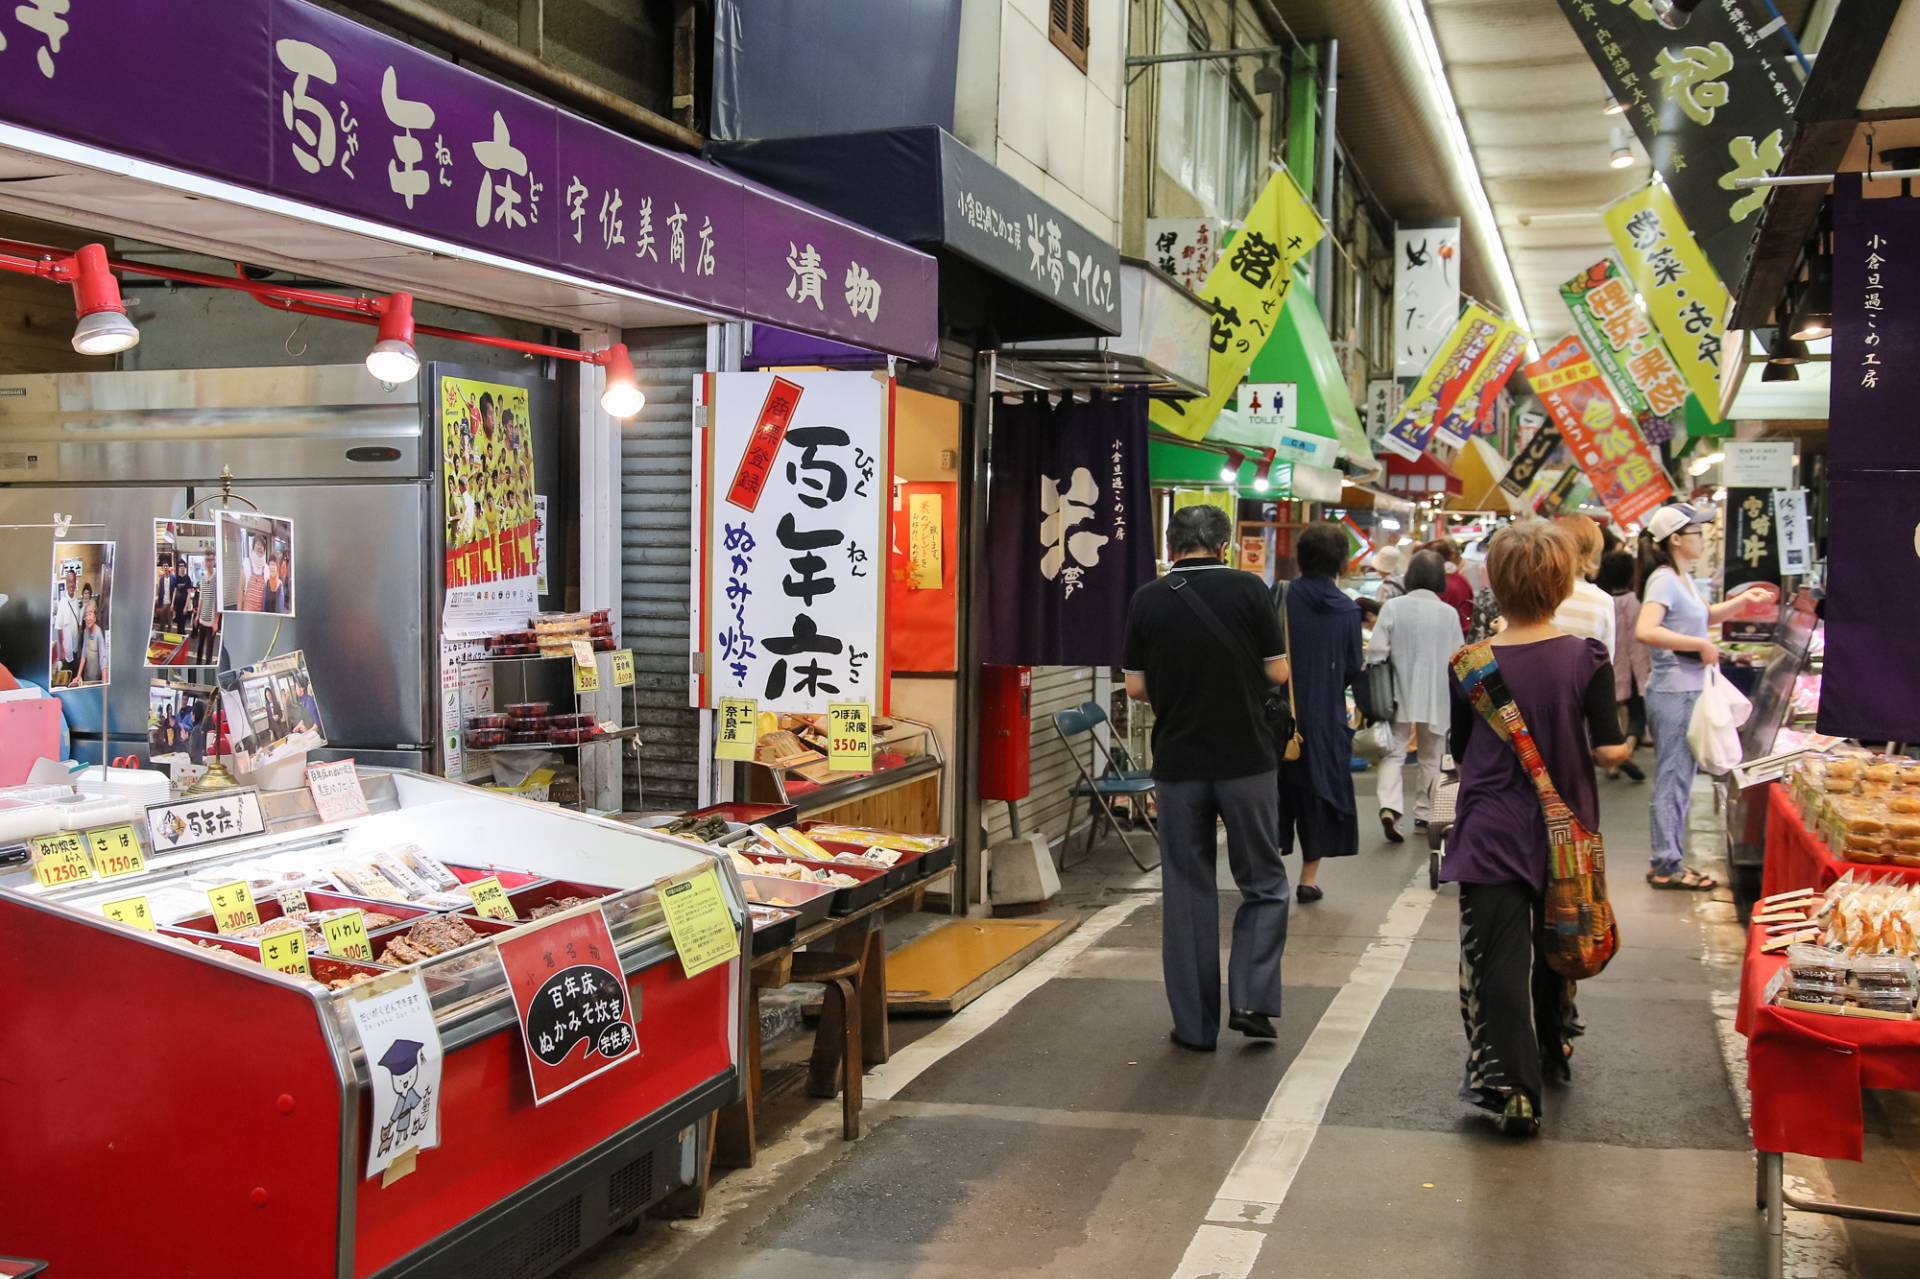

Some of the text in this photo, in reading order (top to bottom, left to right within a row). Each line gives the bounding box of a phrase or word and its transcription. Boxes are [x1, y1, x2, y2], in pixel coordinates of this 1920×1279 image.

[435, 135, 452, 187] ねん
[529, 172, 544, 223] どこ
[566, 176, 717, 277] 宇佐美商店
[786, 240, 882, 323] 漬物
[1861, 233, 1887, 388] 小倉旦過こめ工房
[1249, 415, 1285, 425] TOILET
[735, 396, 790, 494] 商標登録
[854, 447, 874, 498] ひゃく
[1111, 439, 1126, 541] 小倉旦過こめ工房
[1743, 495, 1772, 568] 宮崎牛
[761, 426, 850, 700] 百年床
[847, 540, 867, 578] ねん
[849, 645, 868, 684] どこ
[724, 706, 738, 740] 奈良漬
[845, 722, 866, 733] 沢庵
[833, 738, 867, 751] 350円
[41, 838, 79, 856] ぬか炊き
[97, 833, 129, 851] さば
[216, 888, 245, 907] さば
[269, 938, 299, 960] さば
[332, 921, 361, 941] いわし
[548, 972, 598, 1009] 百年床
[539, 998, 620, 1055] ぬかみそ炊き
[600, 1026, 631, 1054] 宇佐美
